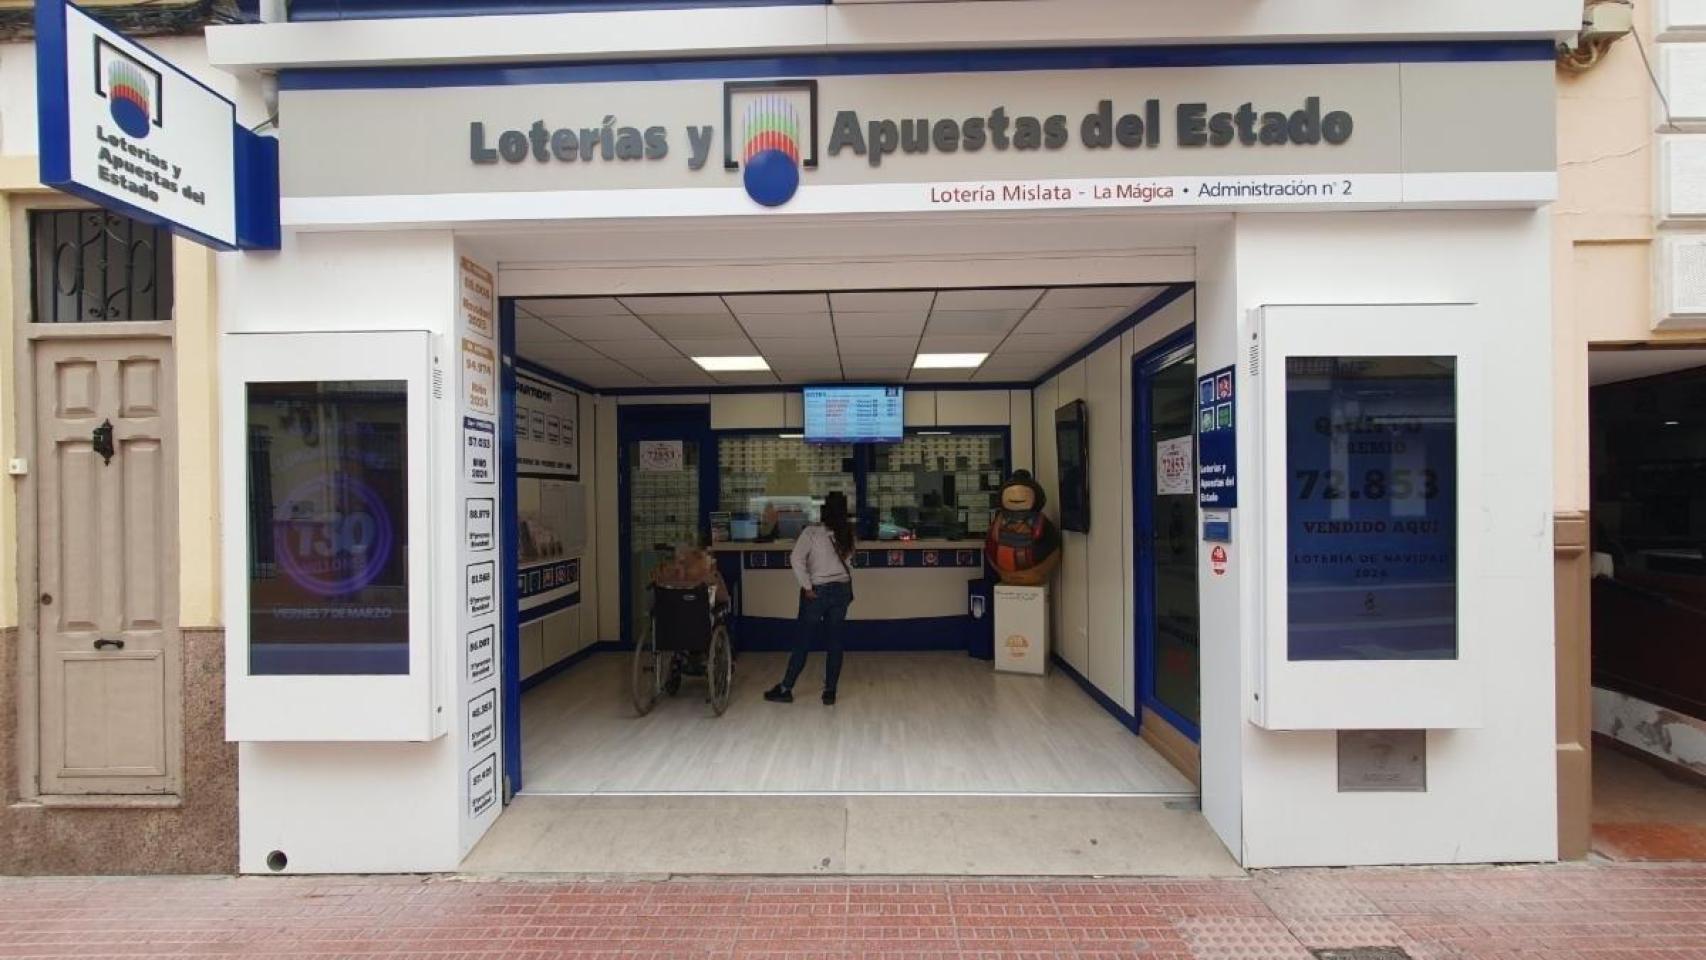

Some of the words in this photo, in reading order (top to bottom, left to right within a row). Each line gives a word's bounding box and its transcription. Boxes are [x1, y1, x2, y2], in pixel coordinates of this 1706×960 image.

[470, 115, 668, 164] Loterías
[686, 125, 713, 170] y
[828, 106, 1069, 167] Apuestas
[1080, 99, 1160, 149] del
[1176, 97, 1354, 148] Estado
[98, 146, 179, 193] Apuestas
[182, 185, 206, 206] del
[98, 164, 159, 203] Estado
[172, 164, 182, 180] y
[931, 185, 996, 203] Lotería
[1002, 184, 1072, 201] Mislata
[1094, 184, 1112, 199] La
[1116, 182, 1174, 202] Mágica
[1198, 180, 1317, 198] Administración
[1342, 180, 1353, 195] 2
[1295, 469, 1440, 501] 72.853
[1303, 520, 1387, 535] VENDIDO
[1359, 553, 1377, 564] DE
